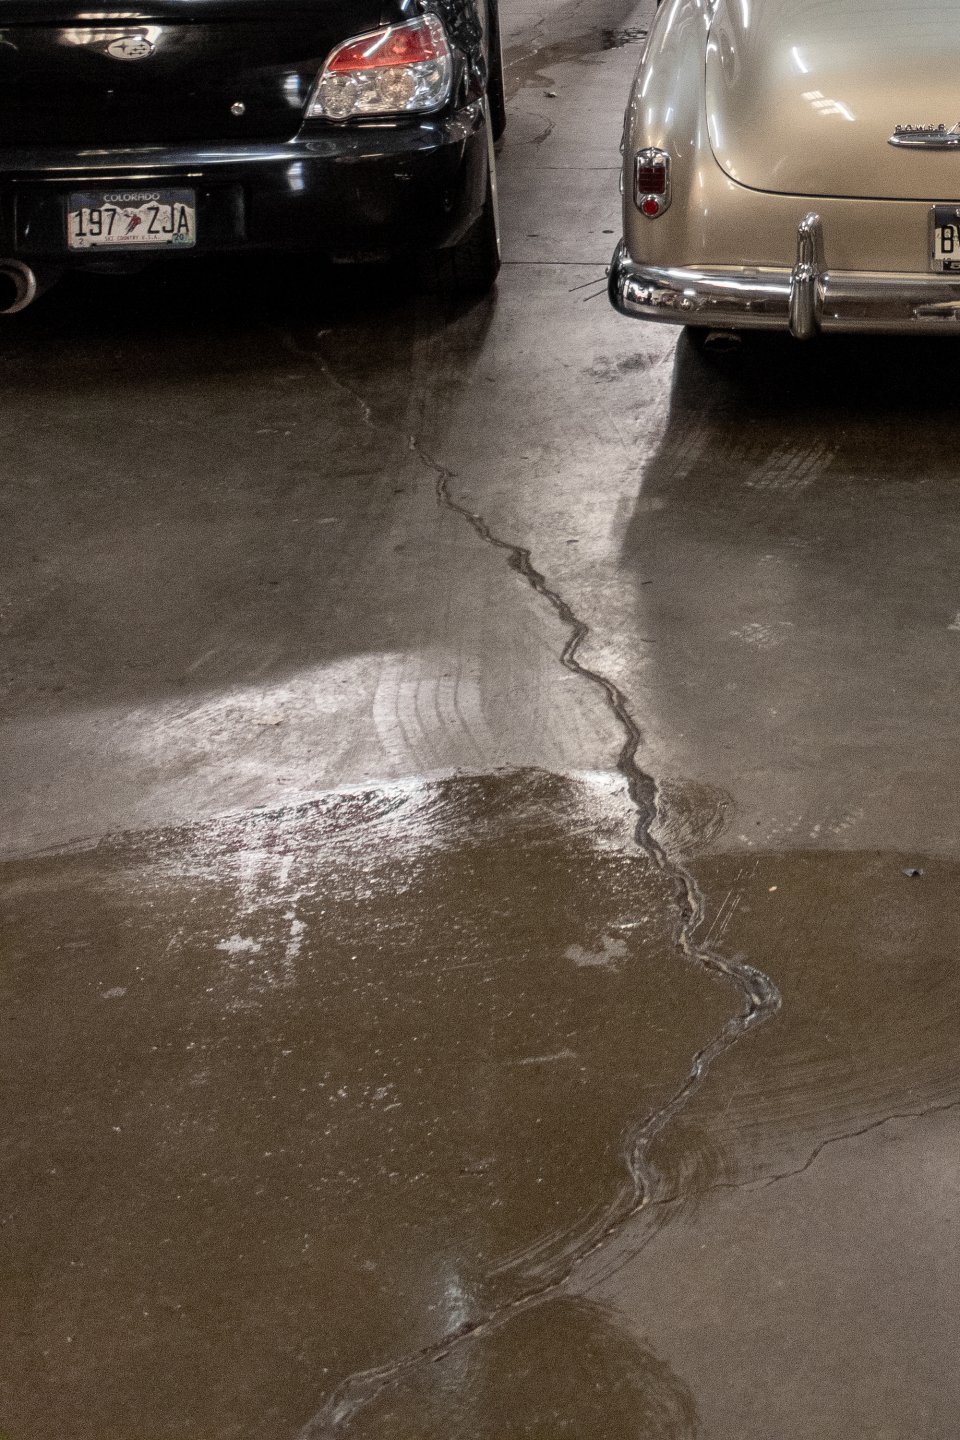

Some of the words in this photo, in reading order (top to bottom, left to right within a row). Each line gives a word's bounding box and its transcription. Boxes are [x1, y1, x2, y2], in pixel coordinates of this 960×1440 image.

[895, 124, 947, 134] POWER
[103, 193, 160, 202] COLORADO
[75, 207, 117, 237] 197
[147, 205, 189, 235] ZJA
